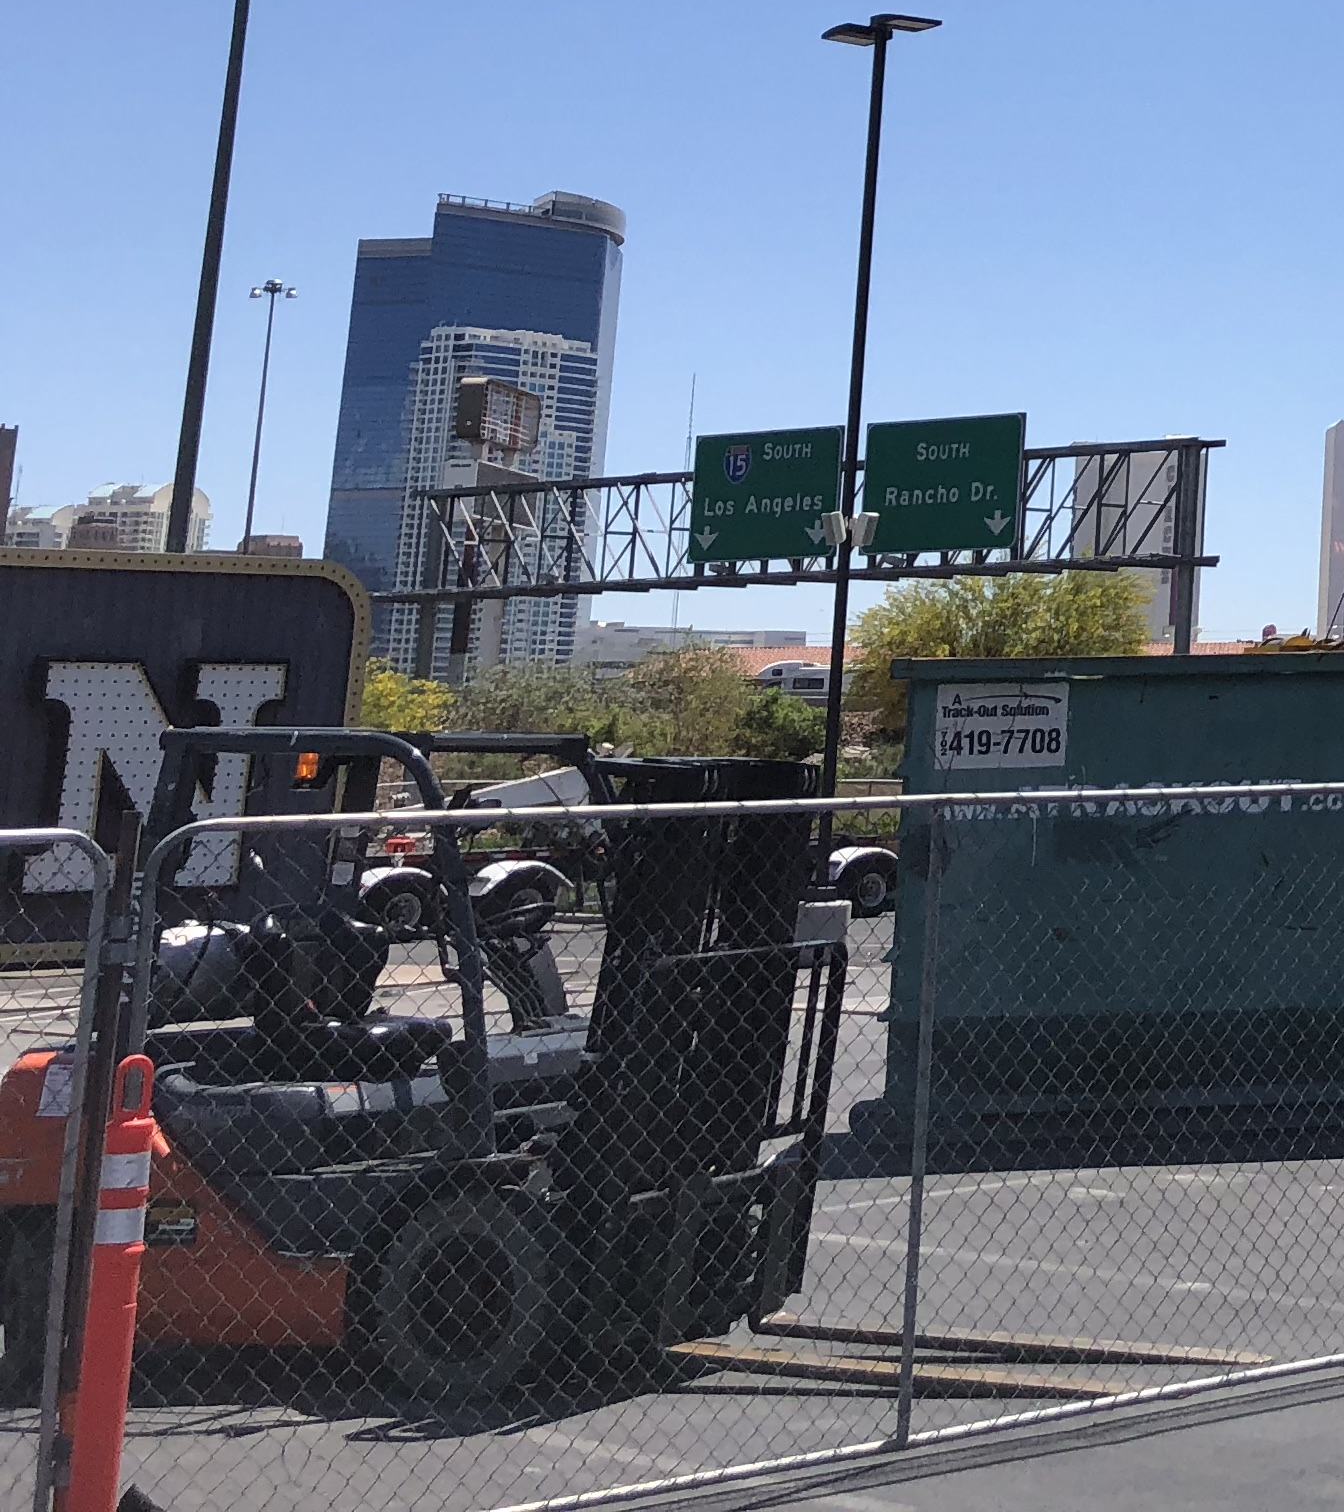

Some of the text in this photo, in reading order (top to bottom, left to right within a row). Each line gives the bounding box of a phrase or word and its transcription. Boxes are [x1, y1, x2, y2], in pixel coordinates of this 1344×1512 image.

[728, 442, 812, 476] 15 SOUTH
[916, 442, 970, 461] SOUTH
[704, 492, 823, 518] Los Angeles
[885, 482, 998, 506] Rancho Dr.
[942, 704, 1050, 718] Track-Out Solution
[952, 694, 962, 706] A
[949, 727, 1061, 756] 419-7708
